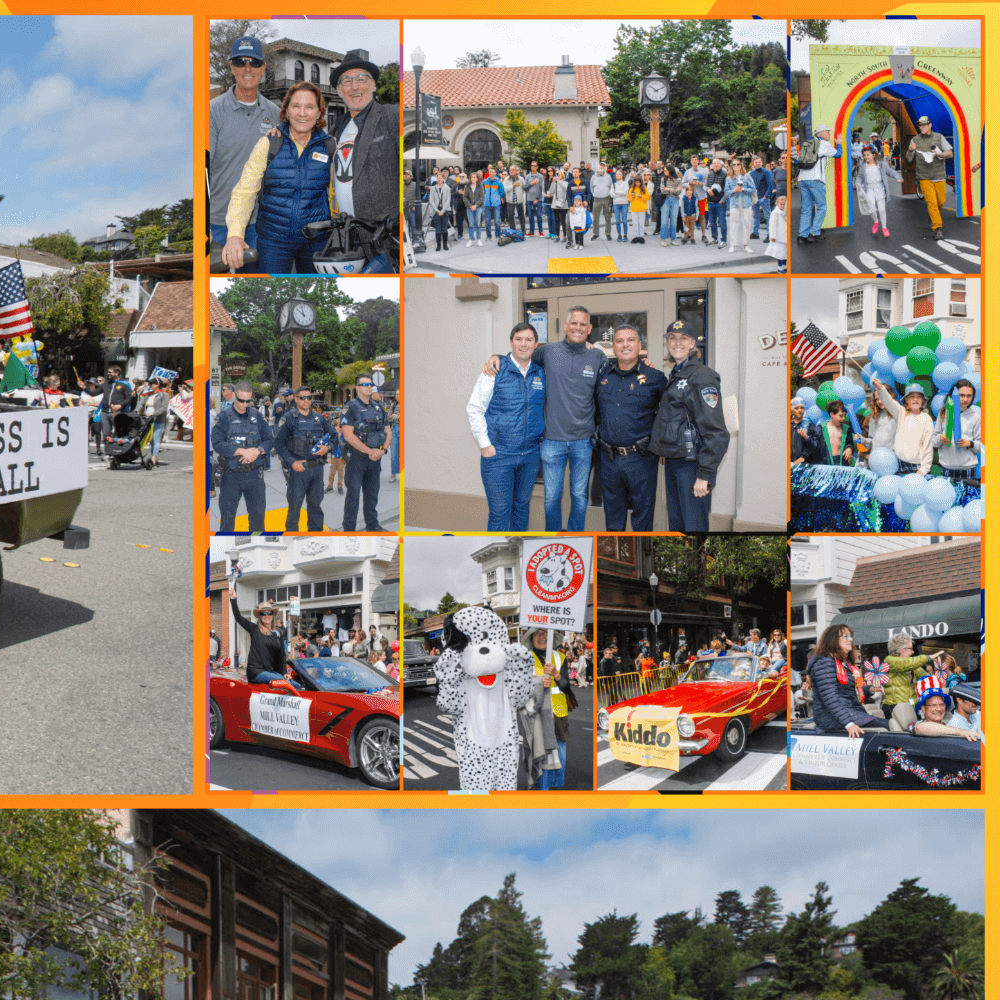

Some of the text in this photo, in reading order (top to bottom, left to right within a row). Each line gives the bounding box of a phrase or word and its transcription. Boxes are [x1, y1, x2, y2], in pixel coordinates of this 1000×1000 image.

[846, 60, 888, 87] NORTH-SOUTH
[917, 60, 955, 86] GREENWAY
[42, 416, 69, 448] IS
[530, 545, 564, 569] ADOPTED
[569, 553, 583, 575] SPOT
[532, 585, 576, 600] CLEANMV.ORG
[532, 604, 571, 615] WHERE IS
[527, 614, 575, 626] YOUR SPOT?
[260, 694, 276, 706] Grand
[259, 710, 299, 726] MILL VALLEY
[614, 721, 671, 748] Kiddo
[796, 743, 858, 756] MILL VALLEY
